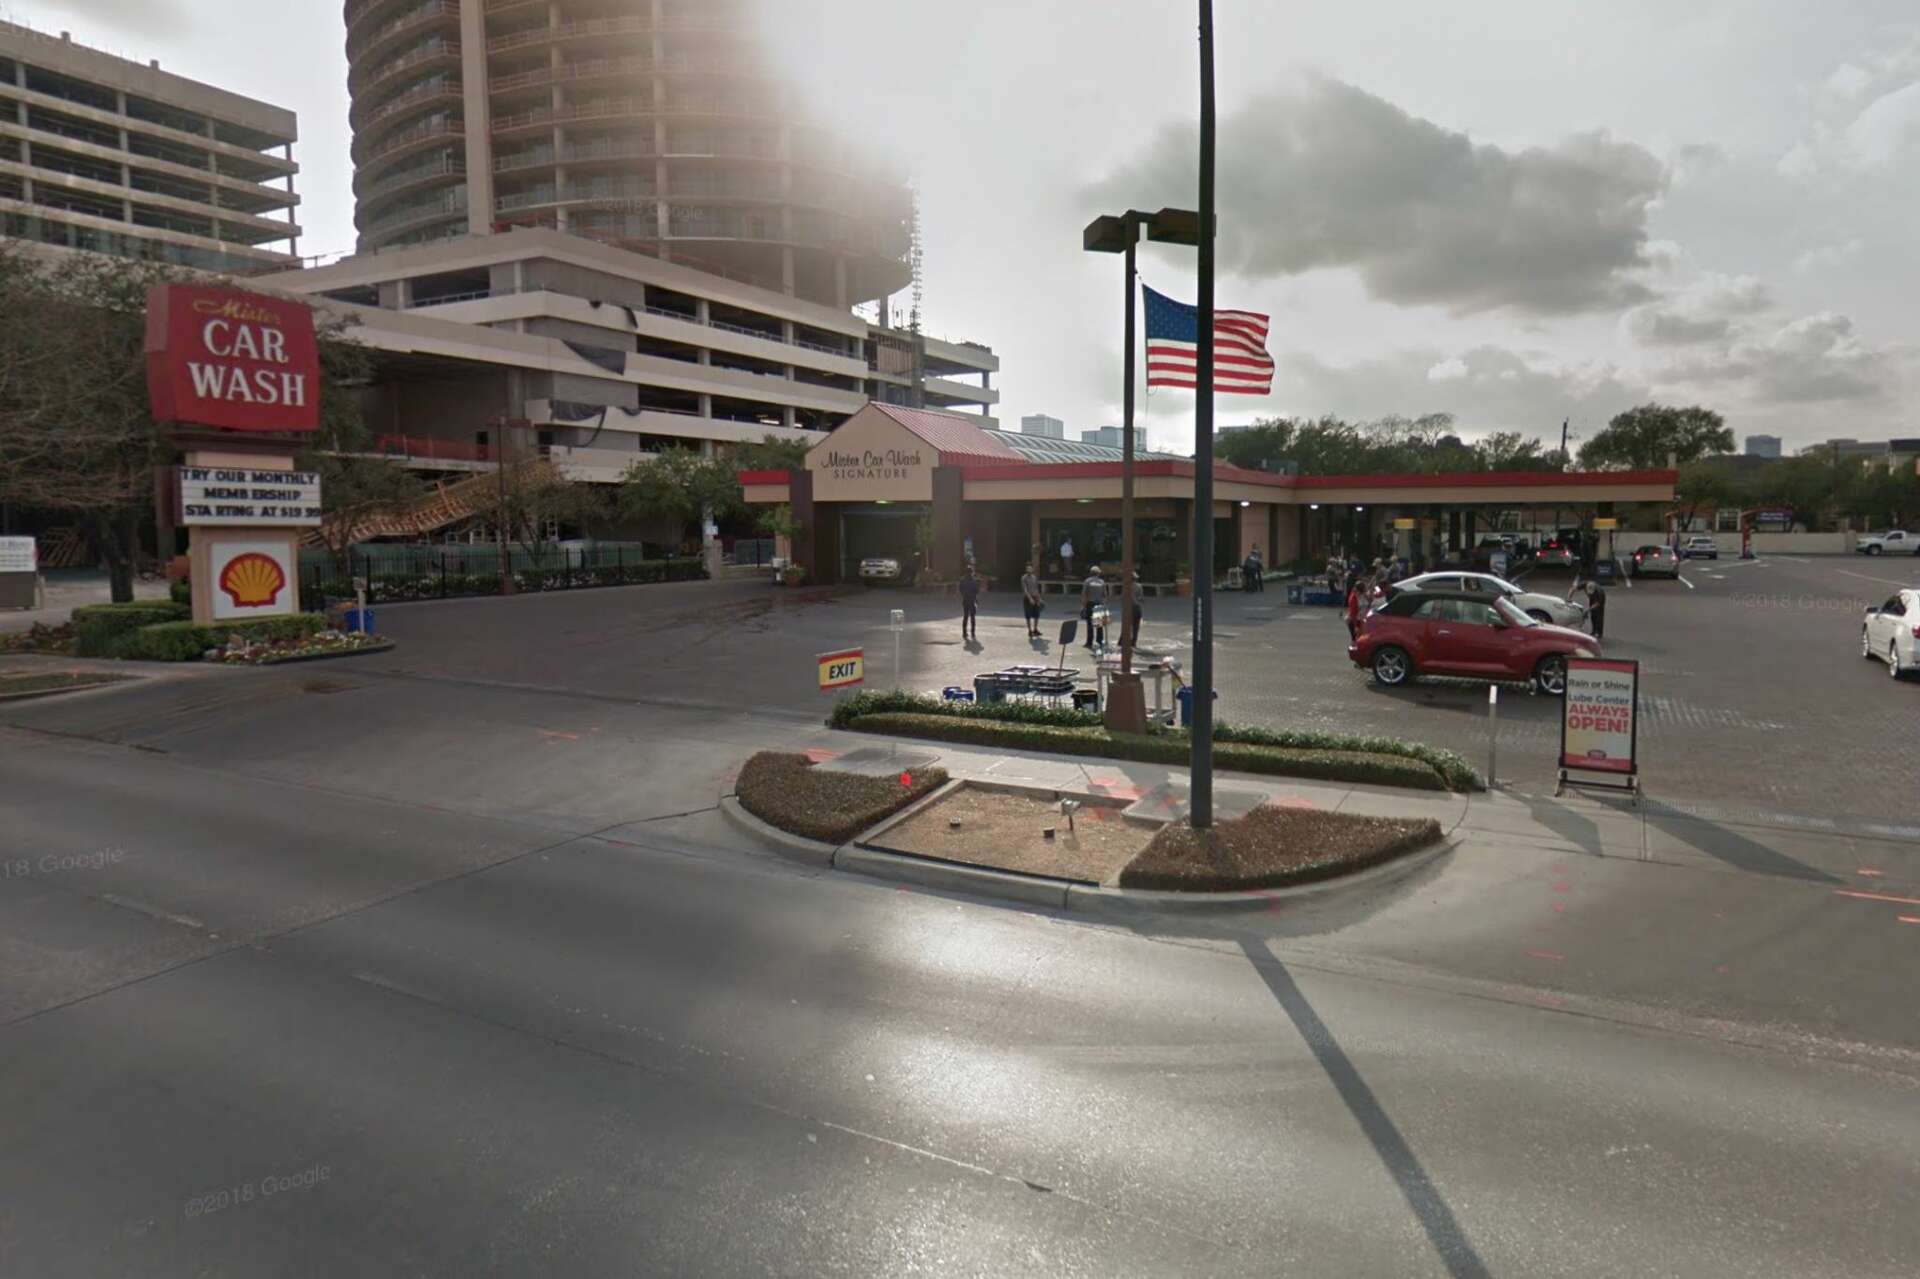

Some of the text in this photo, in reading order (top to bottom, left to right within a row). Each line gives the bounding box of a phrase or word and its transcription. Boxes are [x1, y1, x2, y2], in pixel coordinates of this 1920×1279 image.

[203, 319, 290, 364] CAR
[187, 361, 306, 407] WASH
[182, 469, 315, 485] TRY OUR MONTHLY
[833, 468, 908, 479] SIGNATURE
[260, 506, 278, 518] AT
[829, 661, 856, 680] EXIT
[1569, 703, 1630, 718] ALWAYS
[1568, 715, 1629, 734] OPEN!
